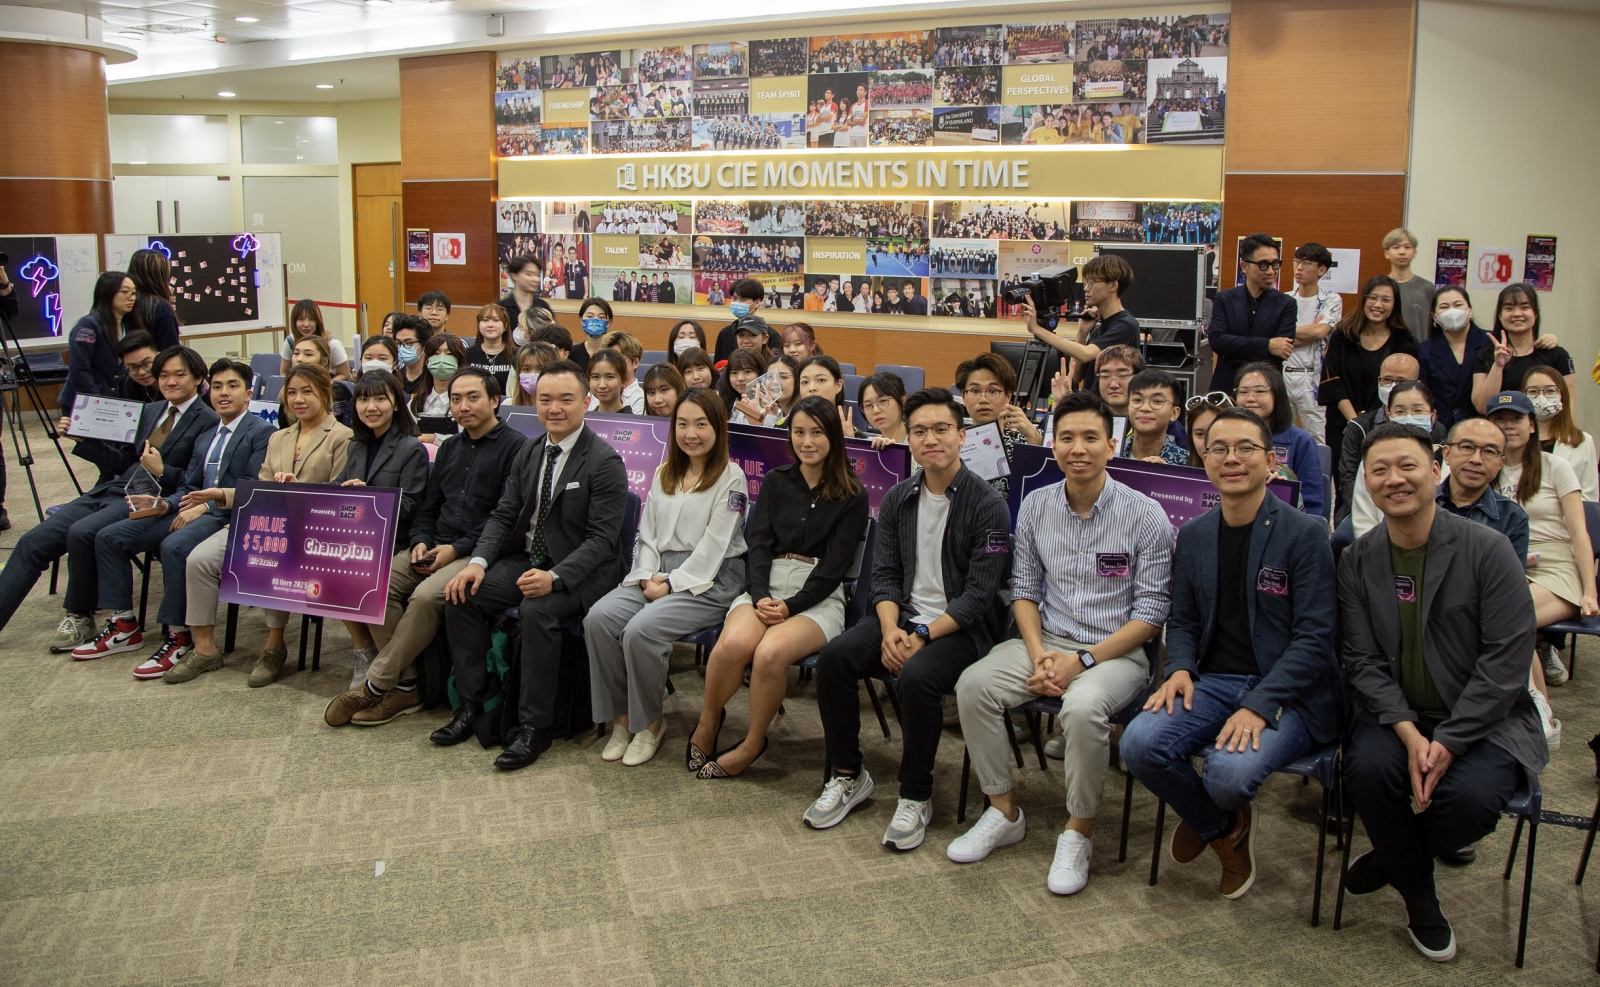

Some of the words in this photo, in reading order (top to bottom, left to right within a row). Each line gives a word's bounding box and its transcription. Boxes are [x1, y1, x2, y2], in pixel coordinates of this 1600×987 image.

[1020, 74, 1056, 82] GLOBAL
[778, 90, 801, 98] SPIRIT
[1006, 86, 1070, 95] PERSPECTIVES
[548, 101, 584, 109] FRIENDSHIP
[643, 163, 710, 188] HKBU
[717, 162, 757, 188] CIE
[764, 161, 908, 188] MOMENTS
[917, 161, 946, 188] IN
[953, 160, 1029, 188] TIME
[812, 252, 860, 260] INSPIRATION
[288, 263, 306, 273] OM
[470, 364, 510, 372] FORNIA
[1151, 491, 1183, 501] Presented
[1203, 493, 1221, 501] SHO
[249, 516, 287, 533] VALUE
[252, 535, 288, 553] 5,000
[304, 538, 373, 560] Champion
[280, 579, 292, 587] Here
